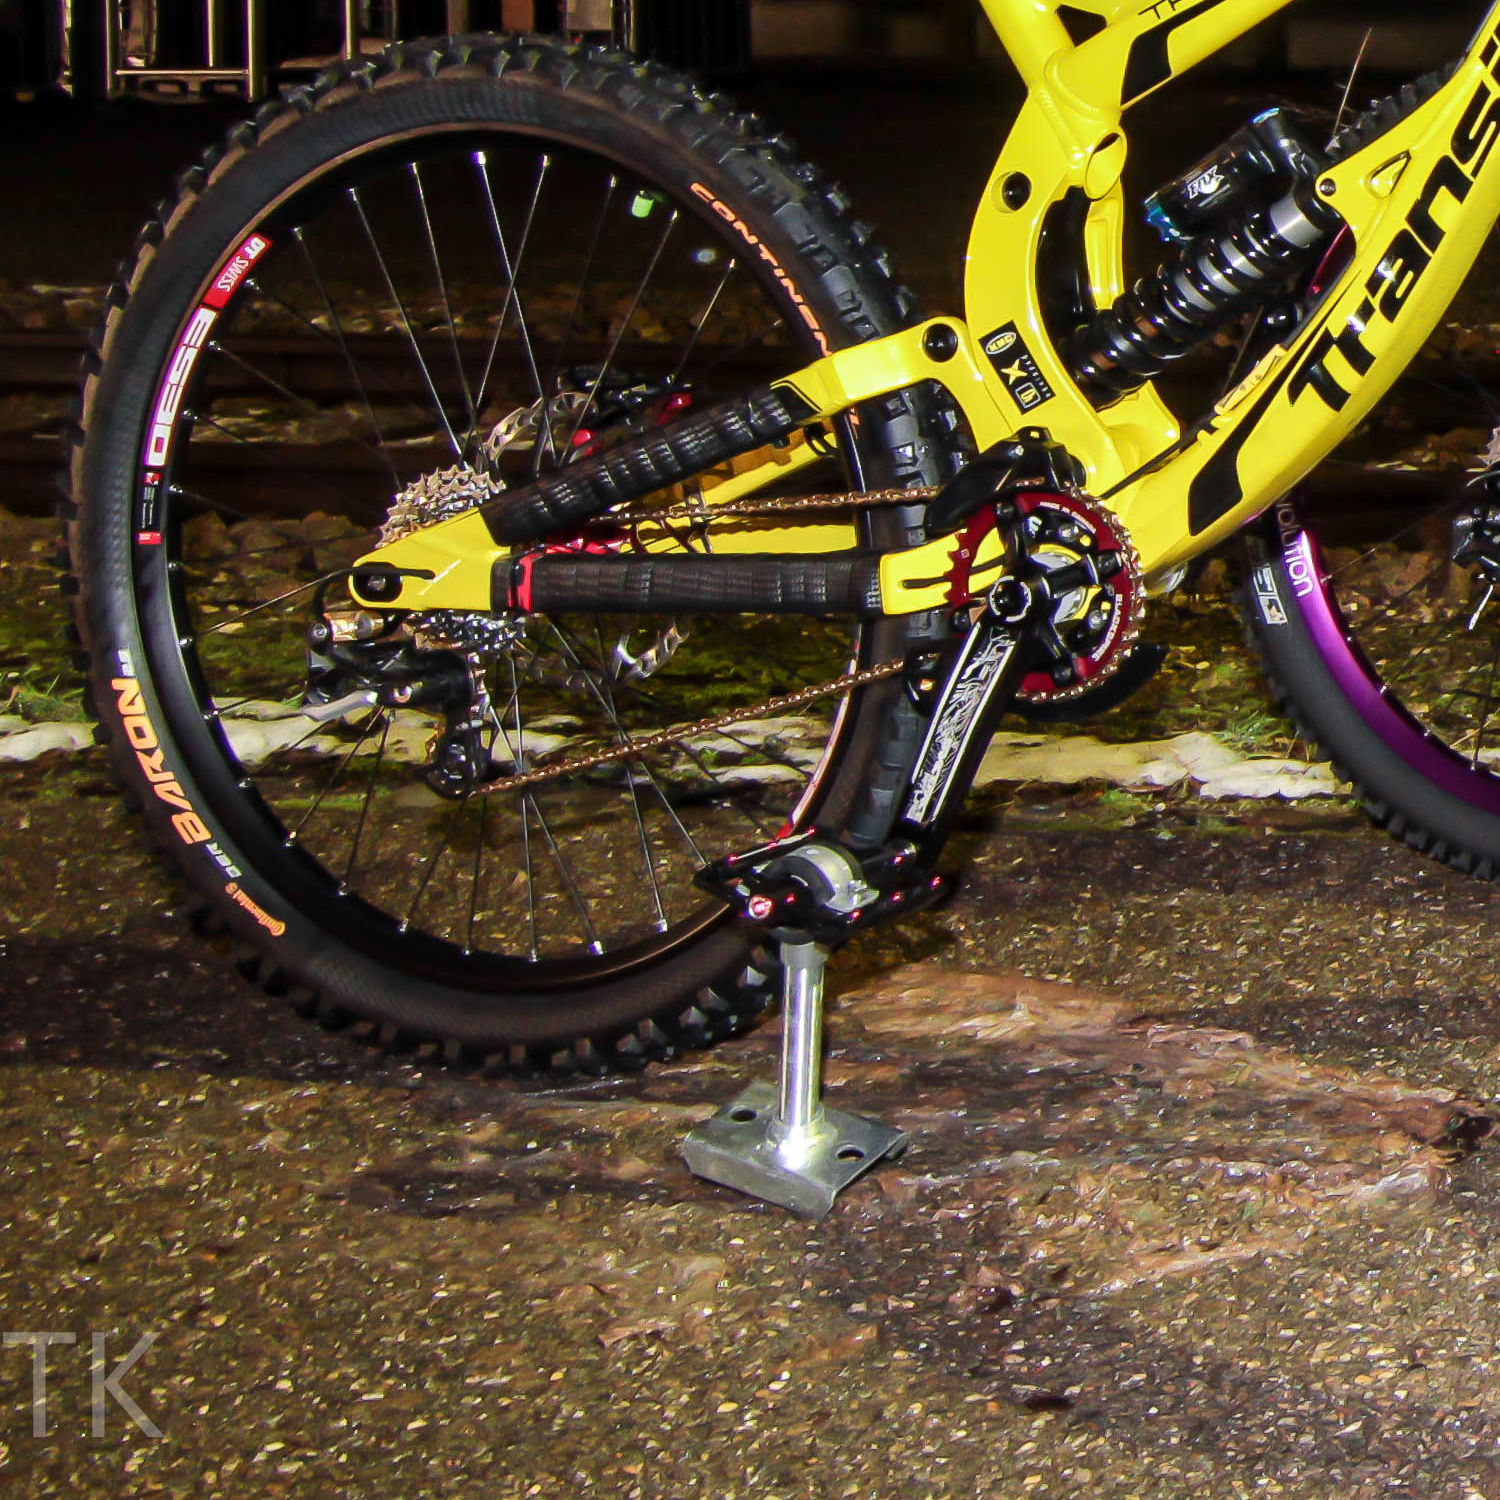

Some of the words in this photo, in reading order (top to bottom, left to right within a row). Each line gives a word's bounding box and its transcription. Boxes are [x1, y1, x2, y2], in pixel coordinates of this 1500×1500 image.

[244, 236, 267, 260] DT
[217, 255, 249, 293] SWISS
[1276, 502, 1314, 597] olution
[111, 674, 213, 846] BARON
[205, 842, 243, 879] DER
